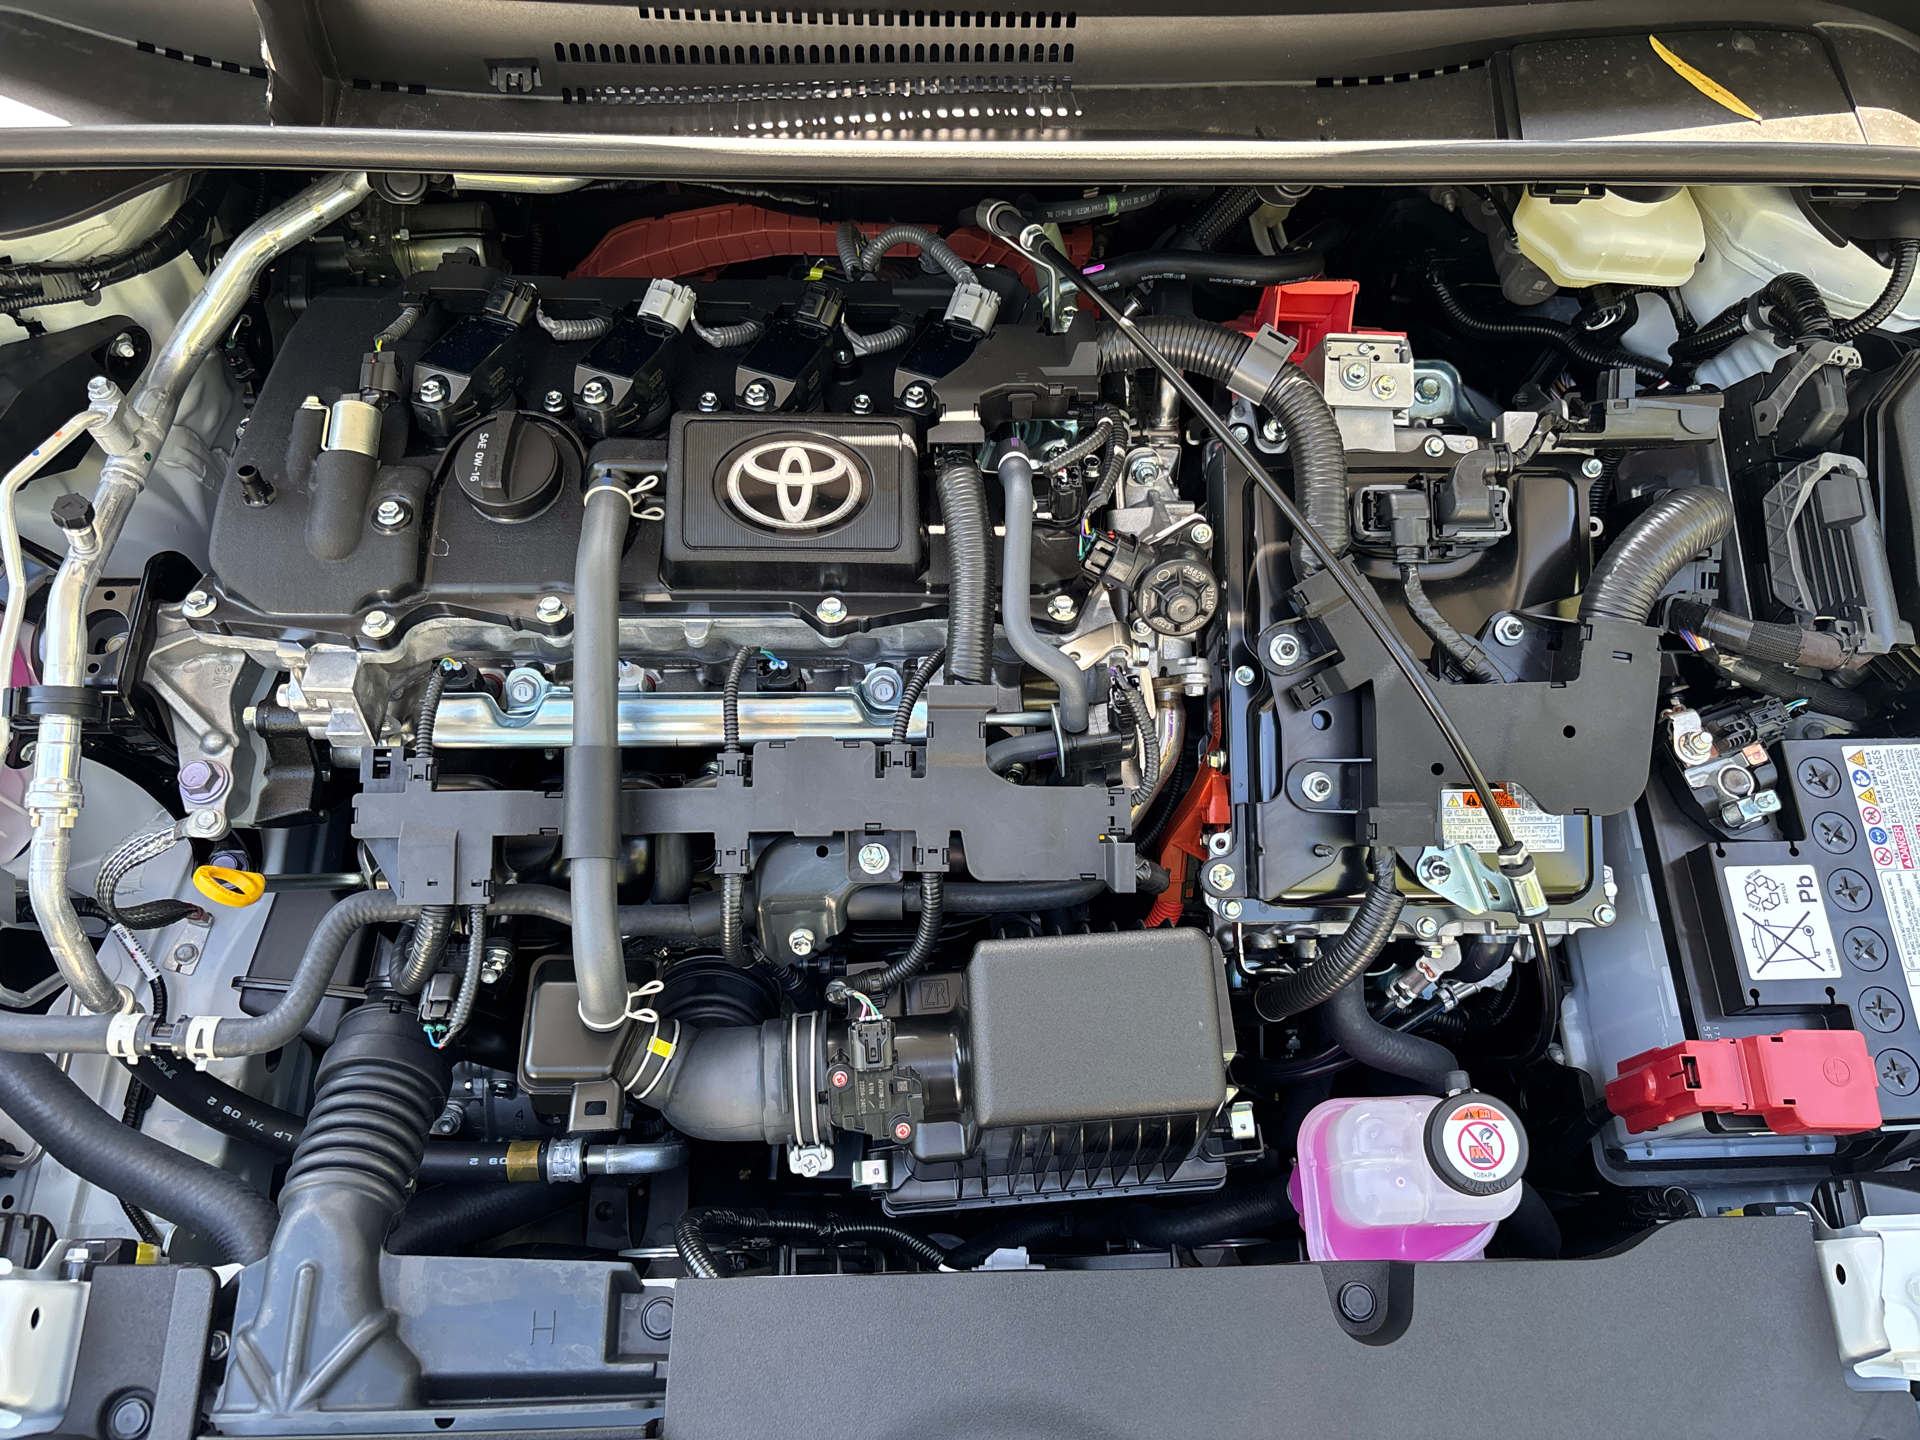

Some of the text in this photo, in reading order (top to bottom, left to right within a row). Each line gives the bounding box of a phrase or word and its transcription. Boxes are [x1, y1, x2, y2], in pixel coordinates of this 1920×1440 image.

[470, 433, 489, 482] SAE 0W-16
[1206, 587, 1214, 610] 37140
[1182, 617, 1204, 631] TOYOTA
[1870, 750, 1886, 775] GASES
[1894, 750, 1908, 770] BURNS
[1901, 772, 1915, 795] SEVERE
[1879, 779, 1900, 823] EXPLOSIVE
[1893, 827, 1910, 858] DANGER
[1780, 883, 1790, 904] RECYCLE
[1796, 875, 1817, 903] Pb
[923, 982, 946, 1006] ZR
[207, 1096, 293, 1142] LP 7K 09 2
[516, 1109, 524, 1119] 4
[1463, 1178, 1508, 1193] DENSO
[530, 1309, 556, 1345] H
